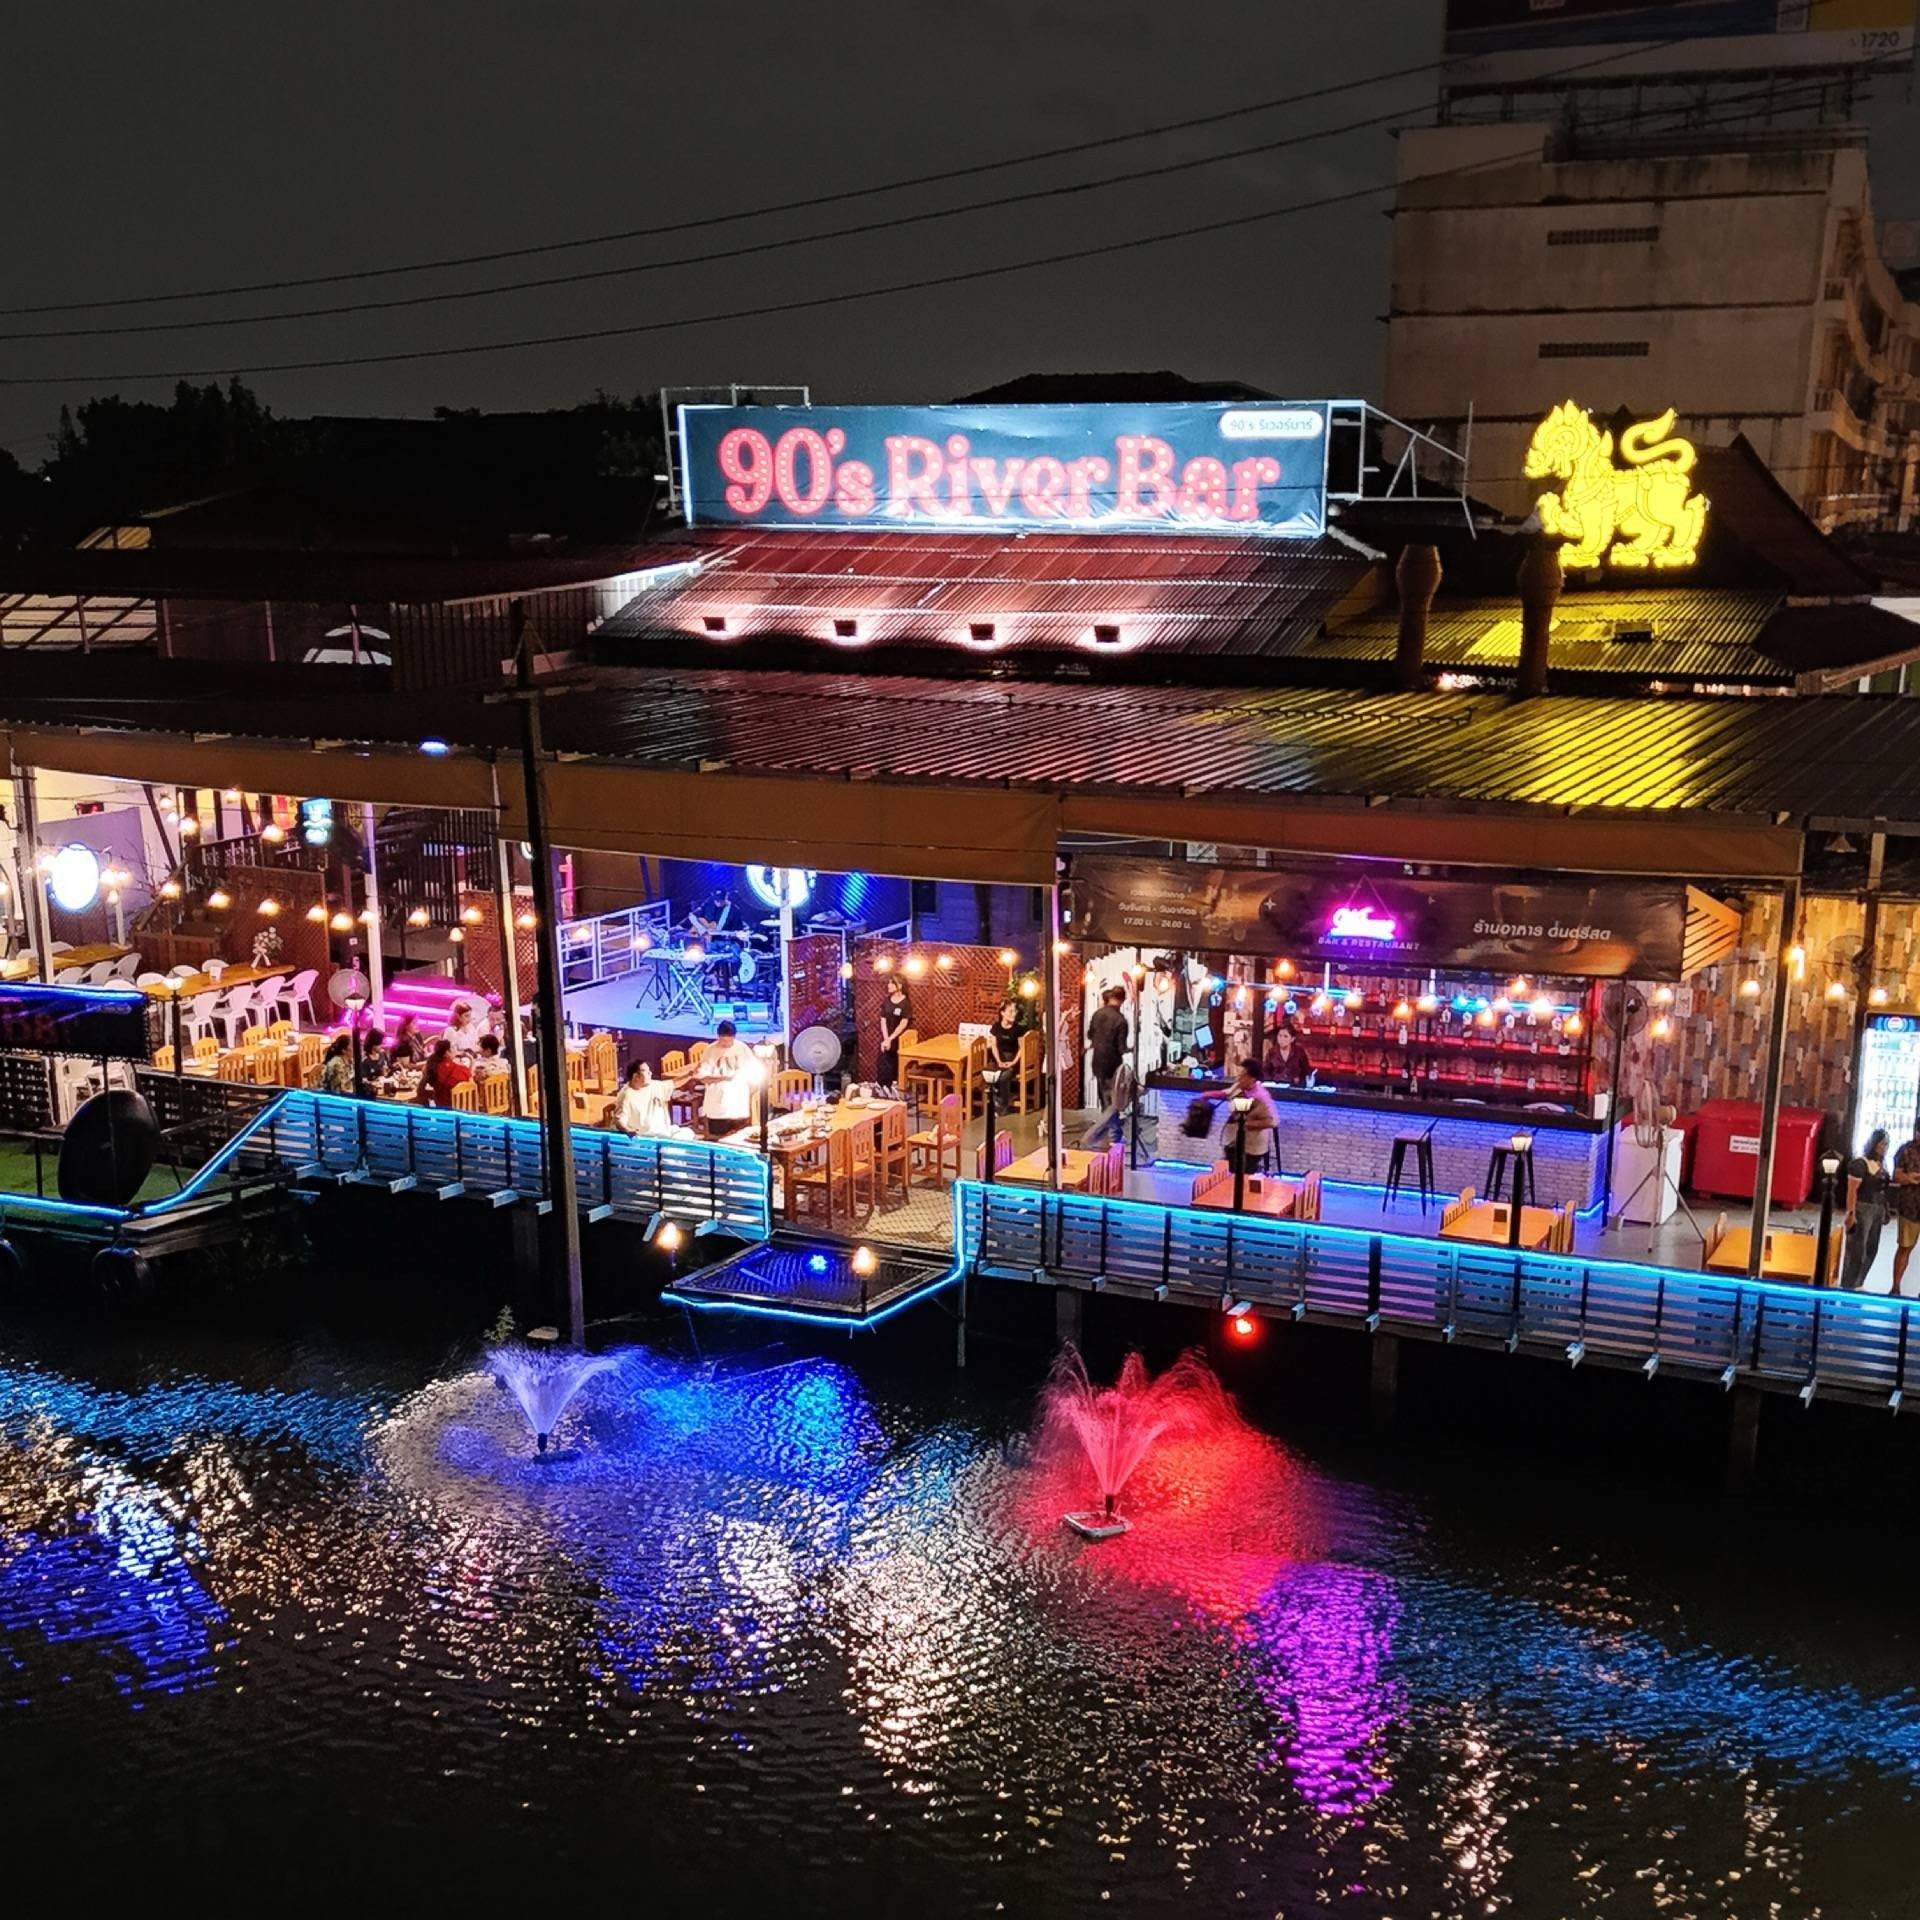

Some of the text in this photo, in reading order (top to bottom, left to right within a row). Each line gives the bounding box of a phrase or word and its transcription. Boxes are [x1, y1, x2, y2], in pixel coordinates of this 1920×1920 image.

[1861, 31, 1900, 47] 1720
[718, 427, 1281, 522] 90's River Bar
[1123, 917, 1144, 926] 17.00
[1161, 919, 1183, 928] 24.00
[1474, 919, 1543, 937] ร้านอาหาร
[1318, 936, 1338, 945] BAR
[1351, 939, 1420, 950] RESTAURANT
